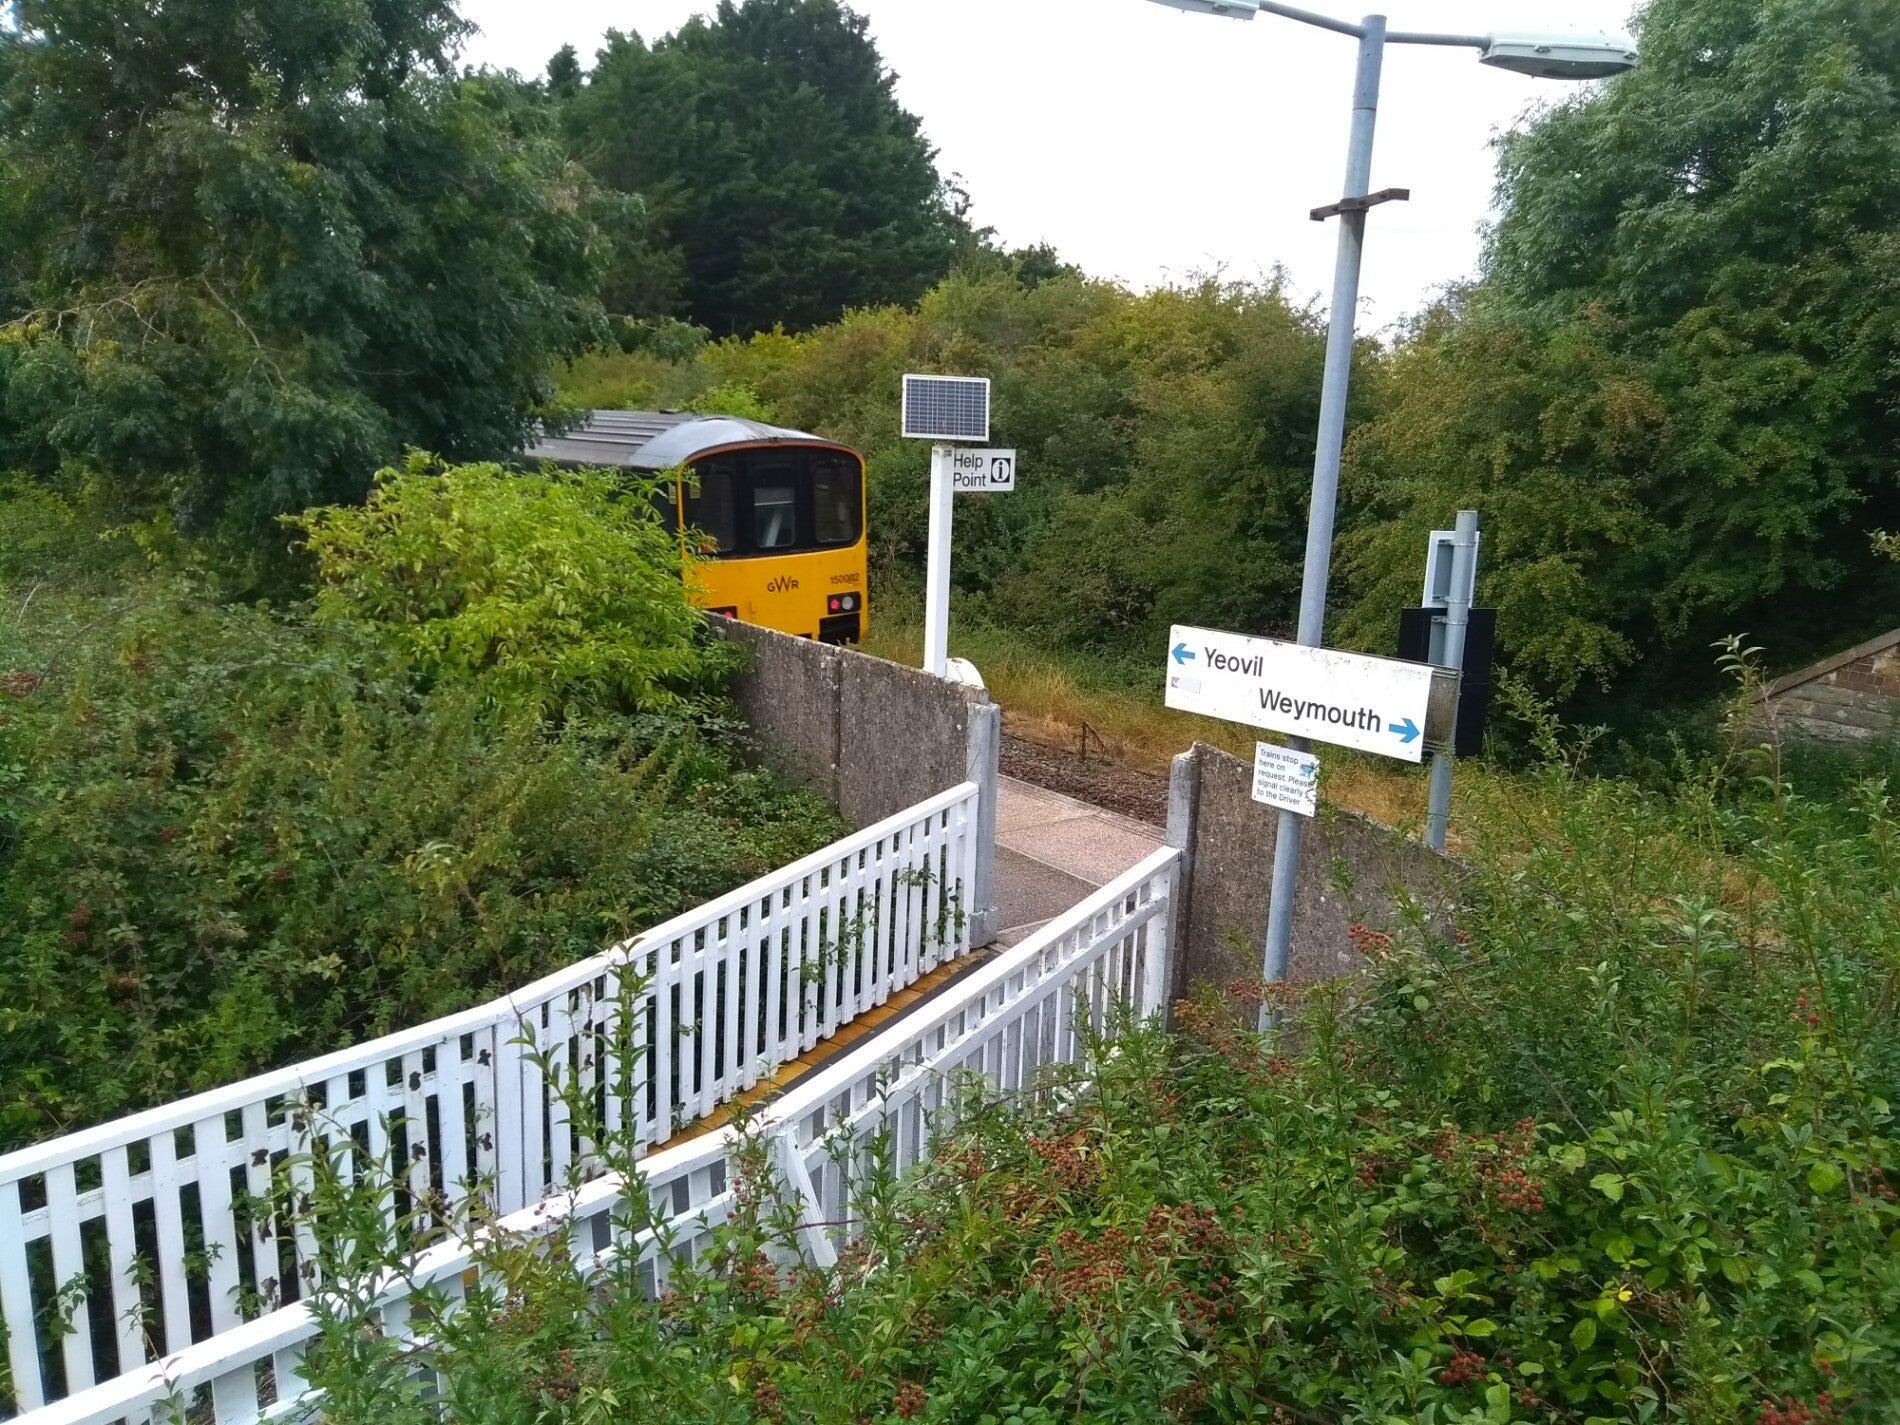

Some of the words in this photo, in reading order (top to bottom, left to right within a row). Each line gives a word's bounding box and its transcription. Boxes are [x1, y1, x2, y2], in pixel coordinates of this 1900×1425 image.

[953, 453, 983, 471] Help
[953, 472, 986, 487] Point
[767, 575, 799, 592] GWR
[1204, 646, 1263, 677] Yeovil
[1259, 687, 1381, 732] Weymouth
[1259, 759, 1275, 769] here
[1260, 748, 1281, 760] Trains
[1283, 754, 1299, 765] stop
[1256, 788, 1264, 796] to
[1266, 790, 1278, 800] the
[1279, 793, 1301, 805] Driver
[1257, 779, 1278, 790] signal
[1279, 785, 1304, 797] clearly
